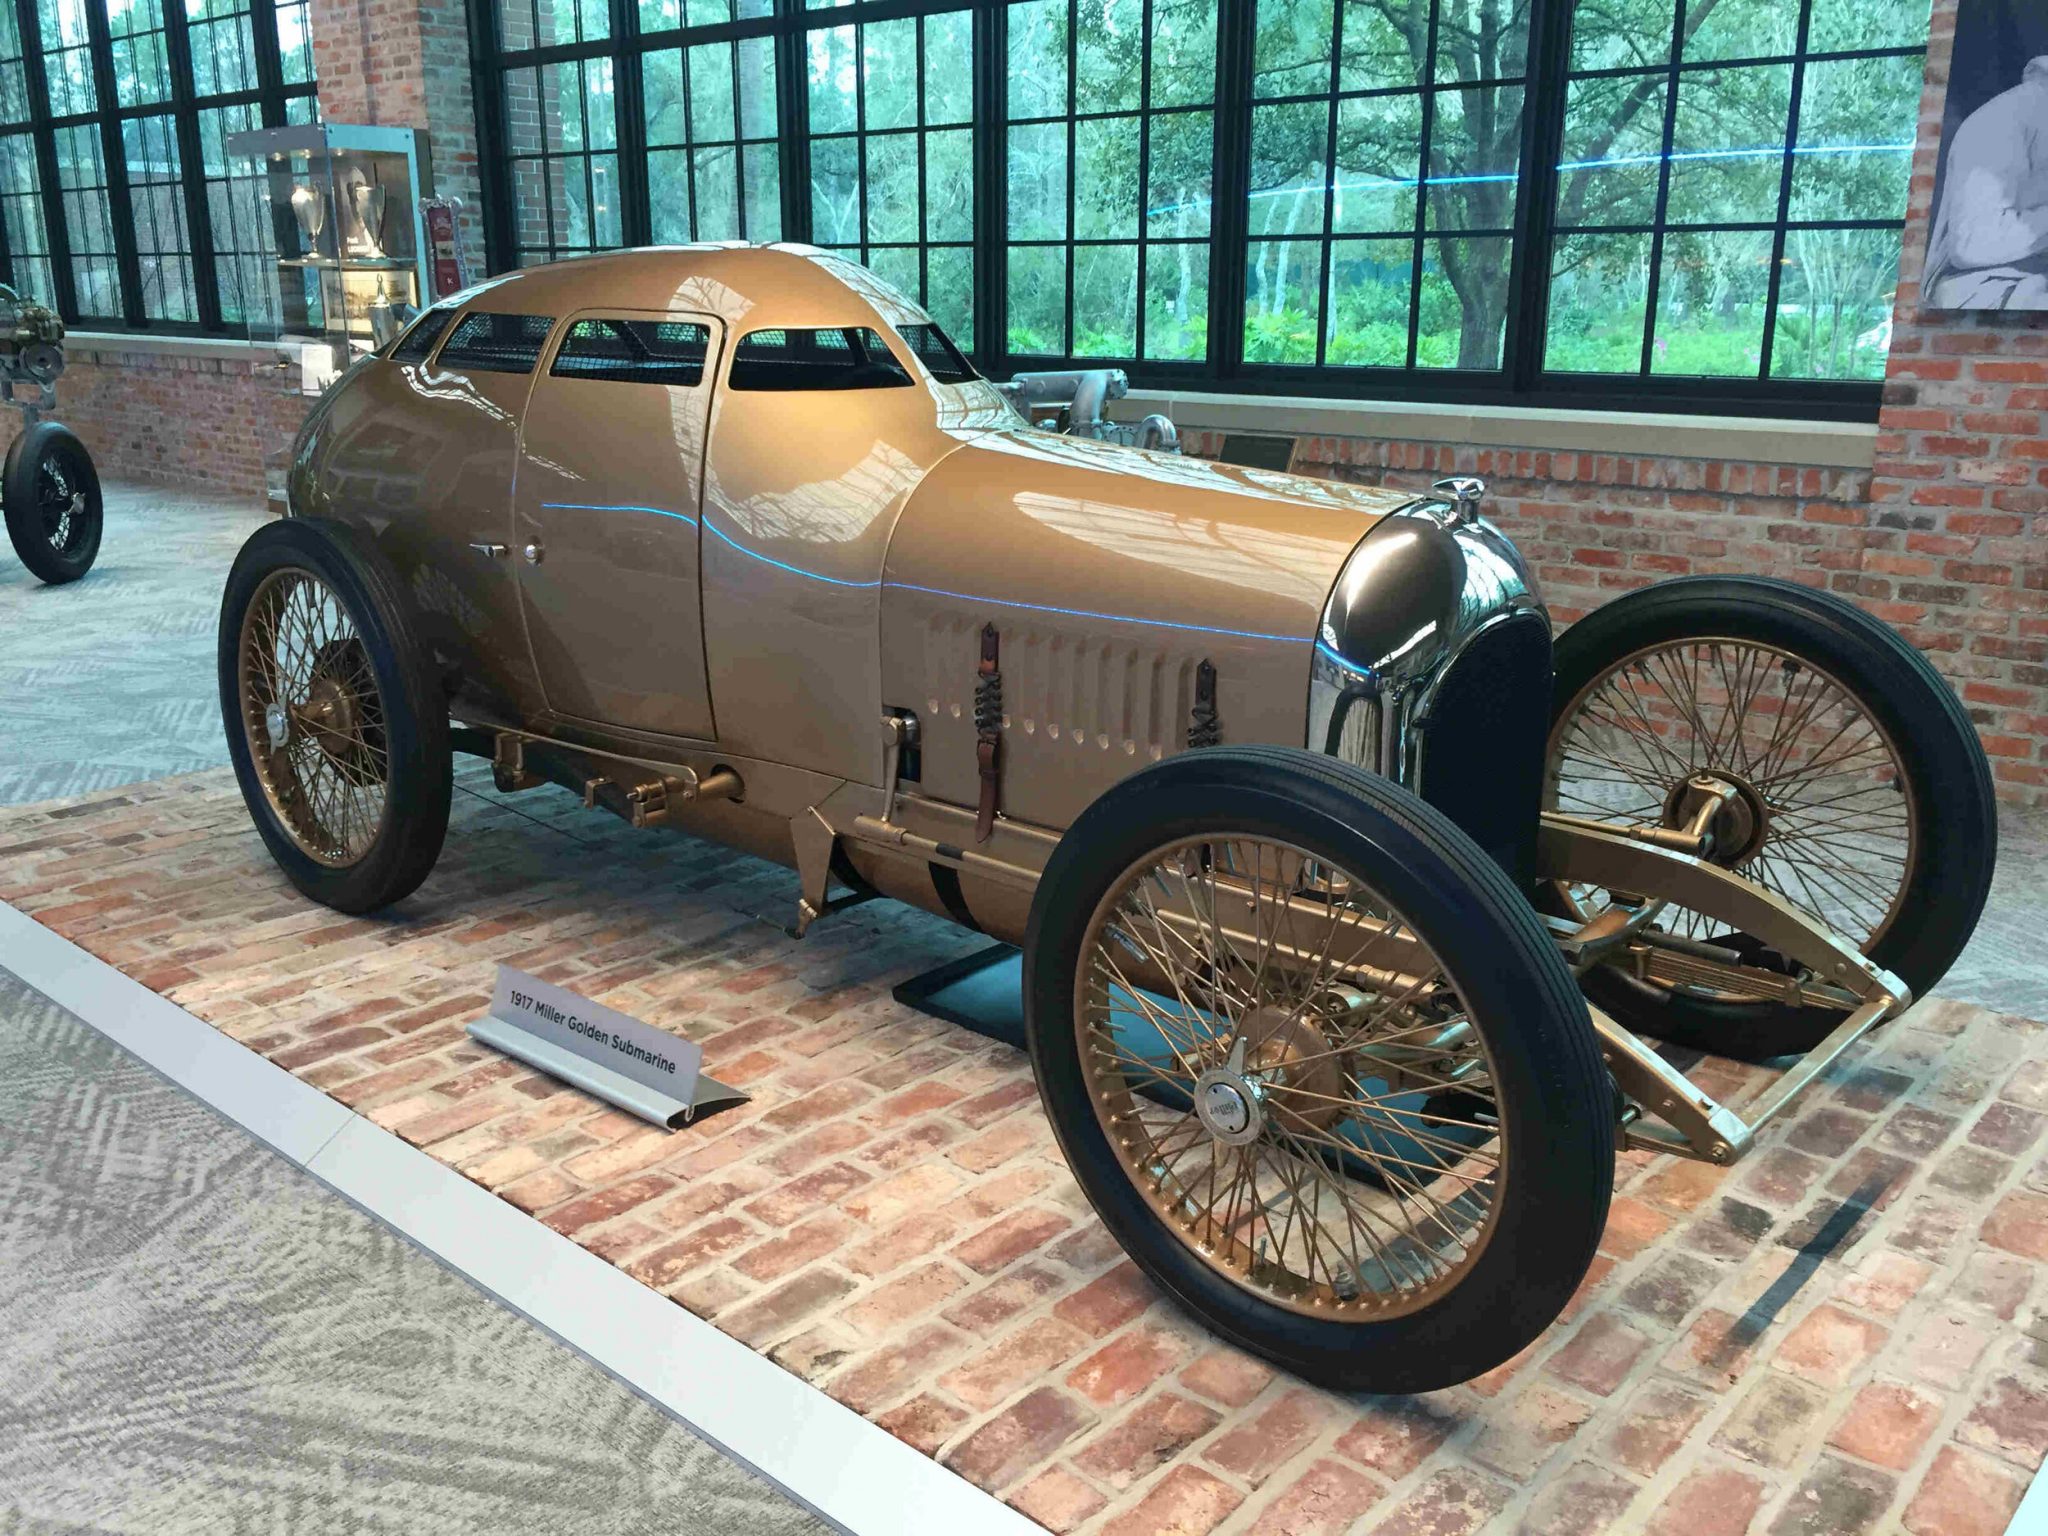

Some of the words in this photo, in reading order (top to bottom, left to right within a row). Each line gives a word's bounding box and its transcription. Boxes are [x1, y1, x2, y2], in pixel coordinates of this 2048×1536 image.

[510, 990, 533, 1010] 1917
[535, 1001, 566, 1025] Miller
[568, 1016, 608, 1045] Golden
[611, 1034, 676, 1074] Submarine
